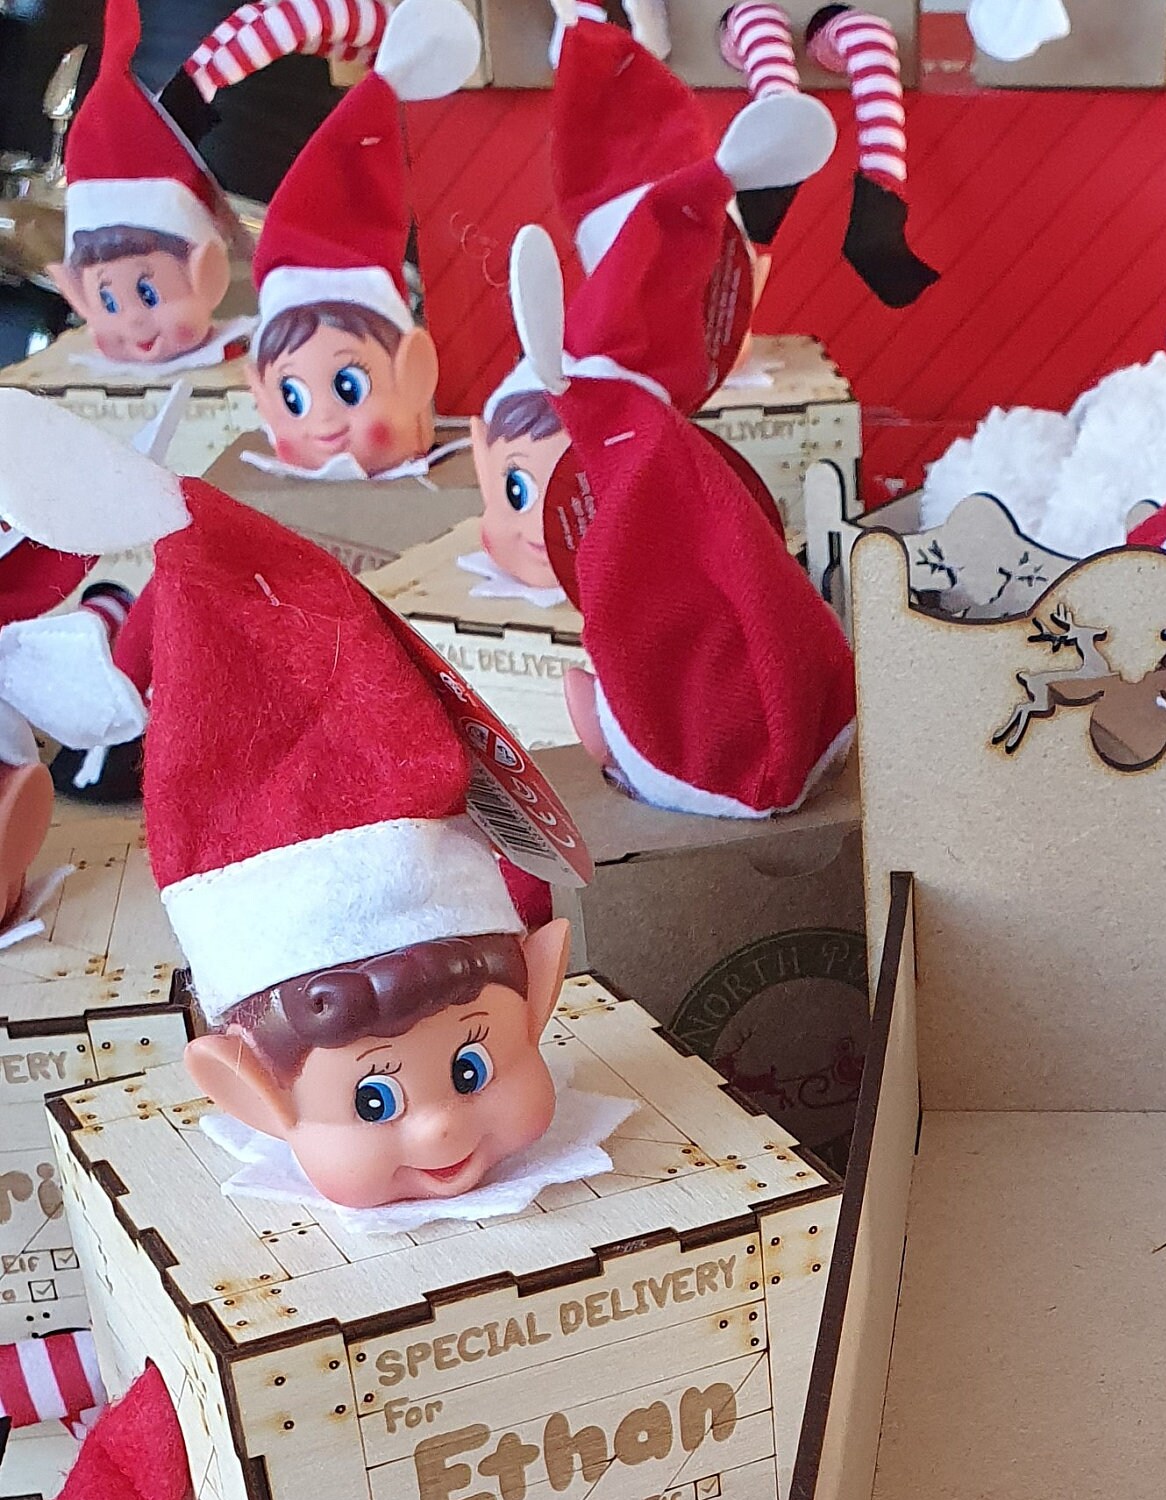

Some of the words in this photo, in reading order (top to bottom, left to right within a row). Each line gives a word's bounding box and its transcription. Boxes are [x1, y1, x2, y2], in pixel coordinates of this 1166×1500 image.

[680, 946, 800, 1048] NORTH
[0, 1051, 67, 1084] ERY
[375, 1310, 552, 1387] SPECIAL
[558, 1253, 737, 1336] DELIVERY
[382, 1396, 444, 1434] For
